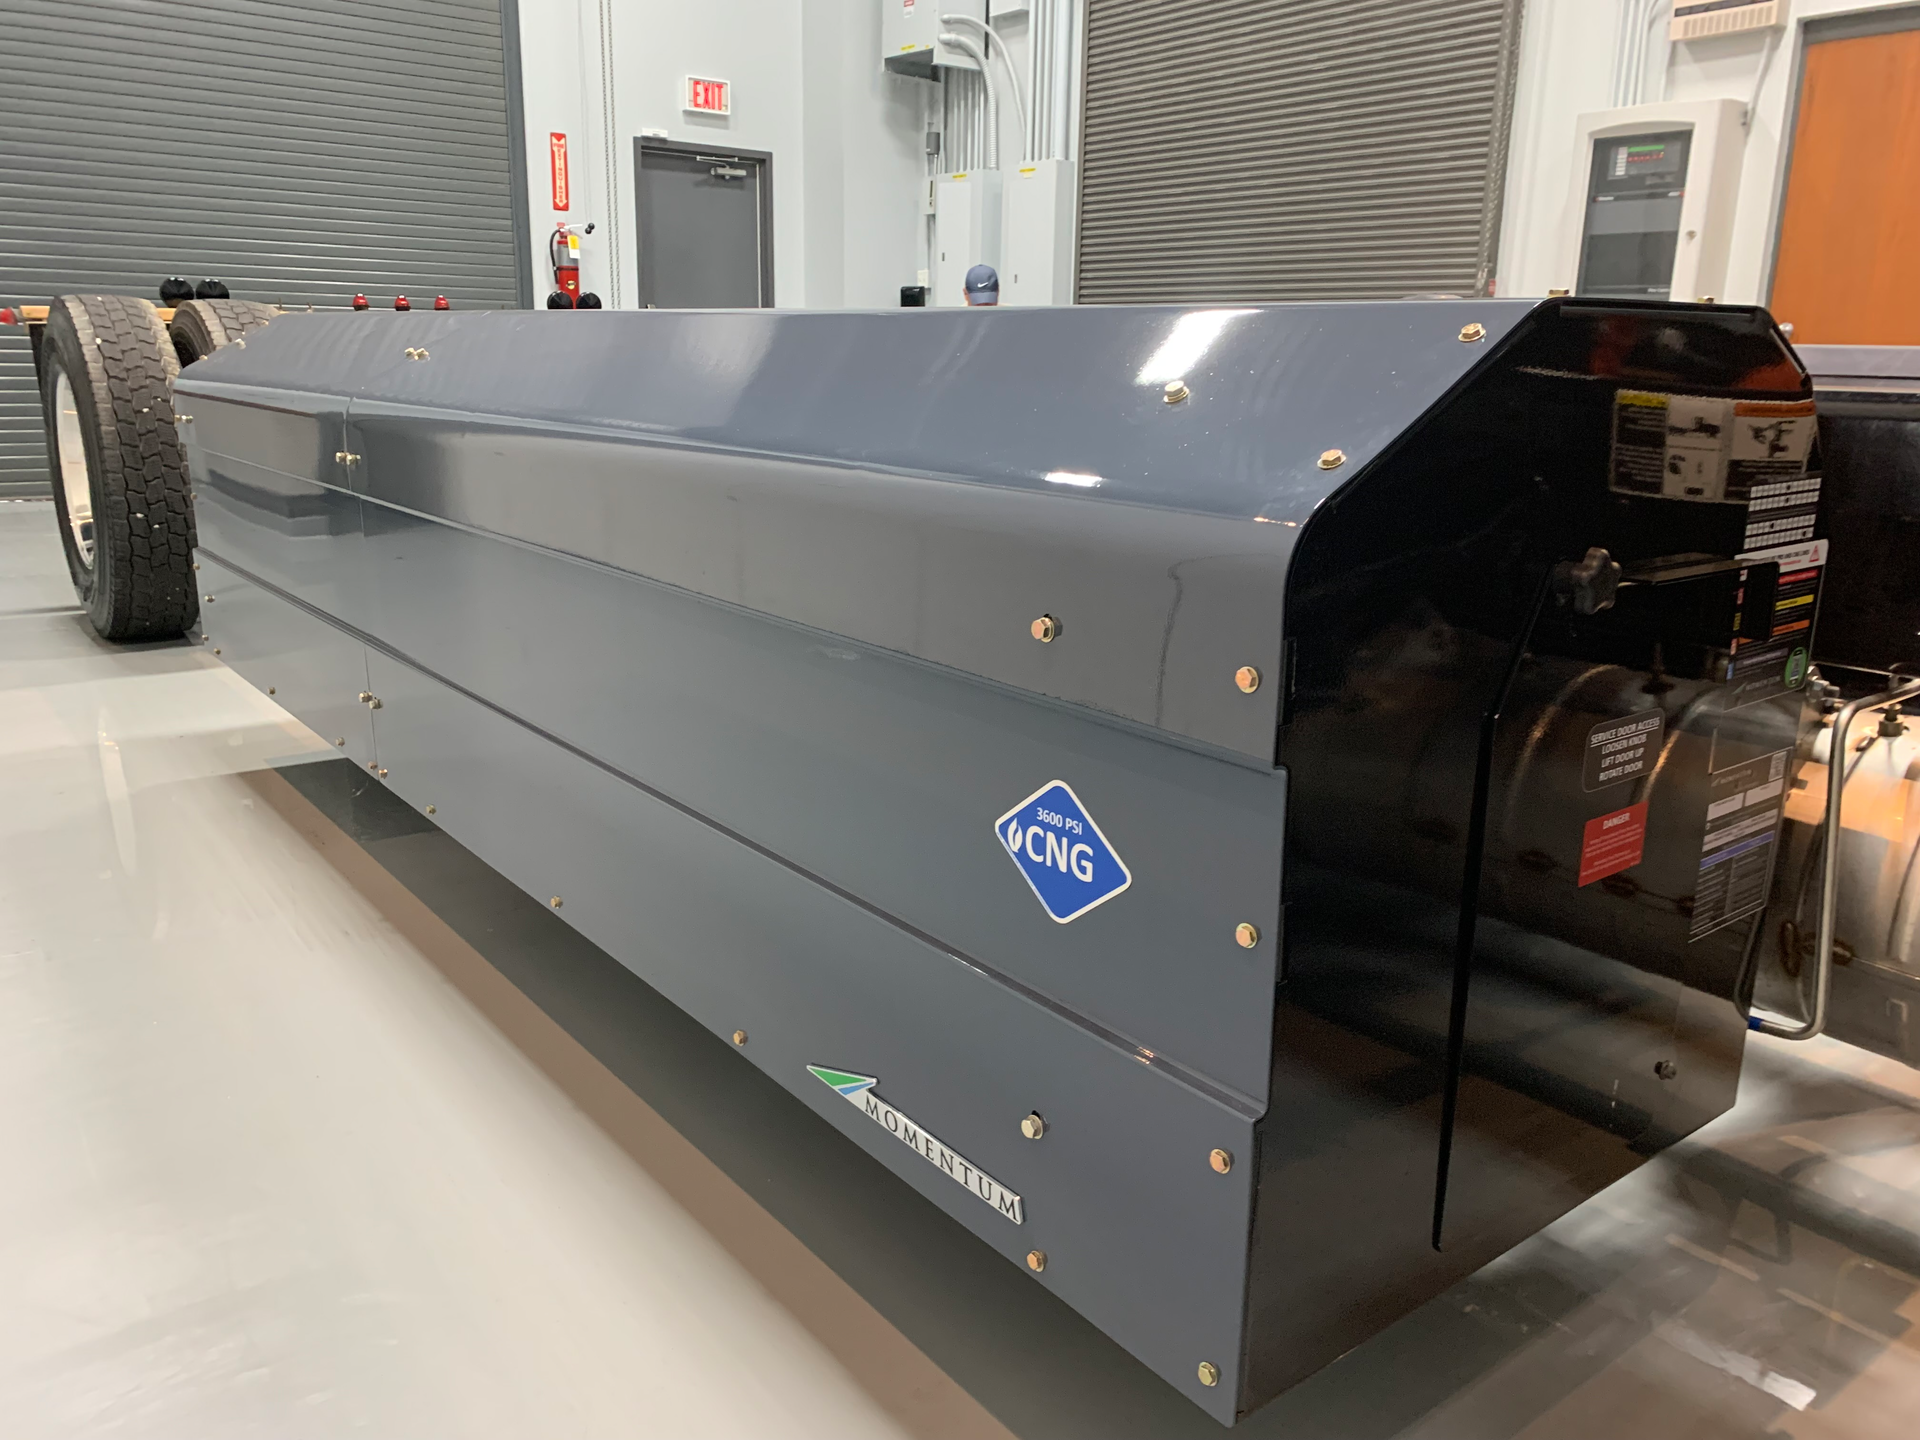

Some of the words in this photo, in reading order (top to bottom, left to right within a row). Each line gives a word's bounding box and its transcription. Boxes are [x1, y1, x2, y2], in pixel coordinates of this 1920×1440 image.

[693, 81, 724, 111] EXIT
[1591, 728, 1616, 744] SERVICE
[1617, 723, 1636, 738] DOOR
[1637, 717, 1660, 731] ACCESS
[1602, 738, 1628, 754] LOOSEN
[1629, 733, 1647, 748] KNOB
[1599, 768, 1623, 782] ROTATE
[1624, 761, 1643, 774] DOOR
[1602, 755, 1614, 768] LIFT
[1615, 751, 1634, 764] DOOR
[1635, 748, 1644, 759] UP
[1036, 807, 1063, 828] 3600
[1065, 817, 1082, 836] PSI
[1603, 812, 1630, 830] DANGER
[1025, 825, 1093, 883] CNG
[865, 1094, 1019, 1222] MOMENTUM
